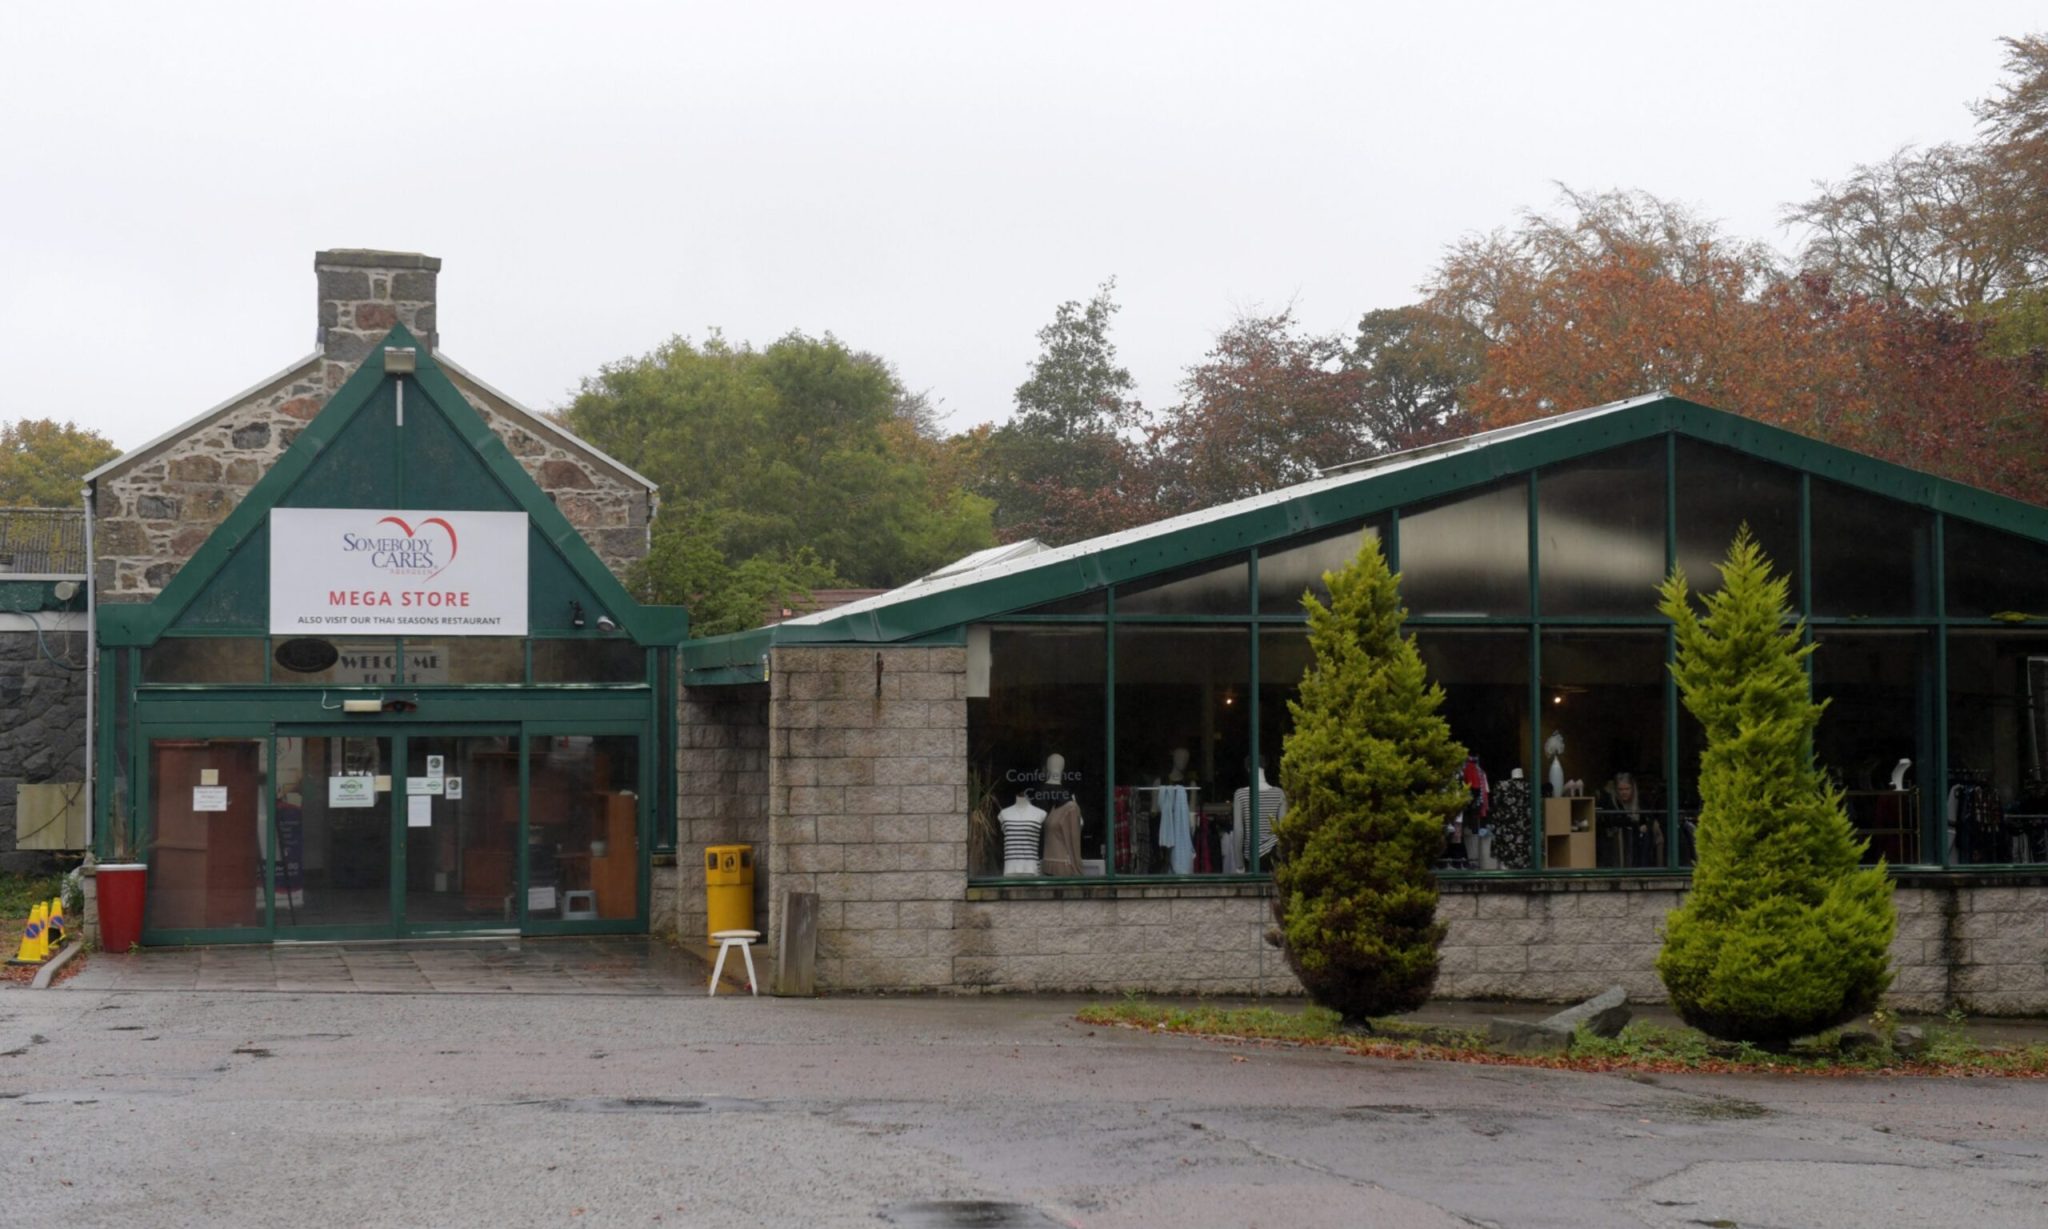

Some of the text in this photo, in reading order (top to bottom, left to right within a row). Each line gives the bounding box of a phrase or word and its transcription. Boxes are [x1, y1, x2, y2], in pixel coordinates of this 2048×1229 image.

[343, 532, 433, 553] SOMEBODY
[371, 551, 433, 569] CARES
[329, 591, 470, 607] MEGA STORE
[298, 616, 501, 625] ALSO VISIT OUR THAI SEASONS RESTAURANT
[1006, 769, 1082, 782] Conference
[1024, 788, 1069, 801] Centre
